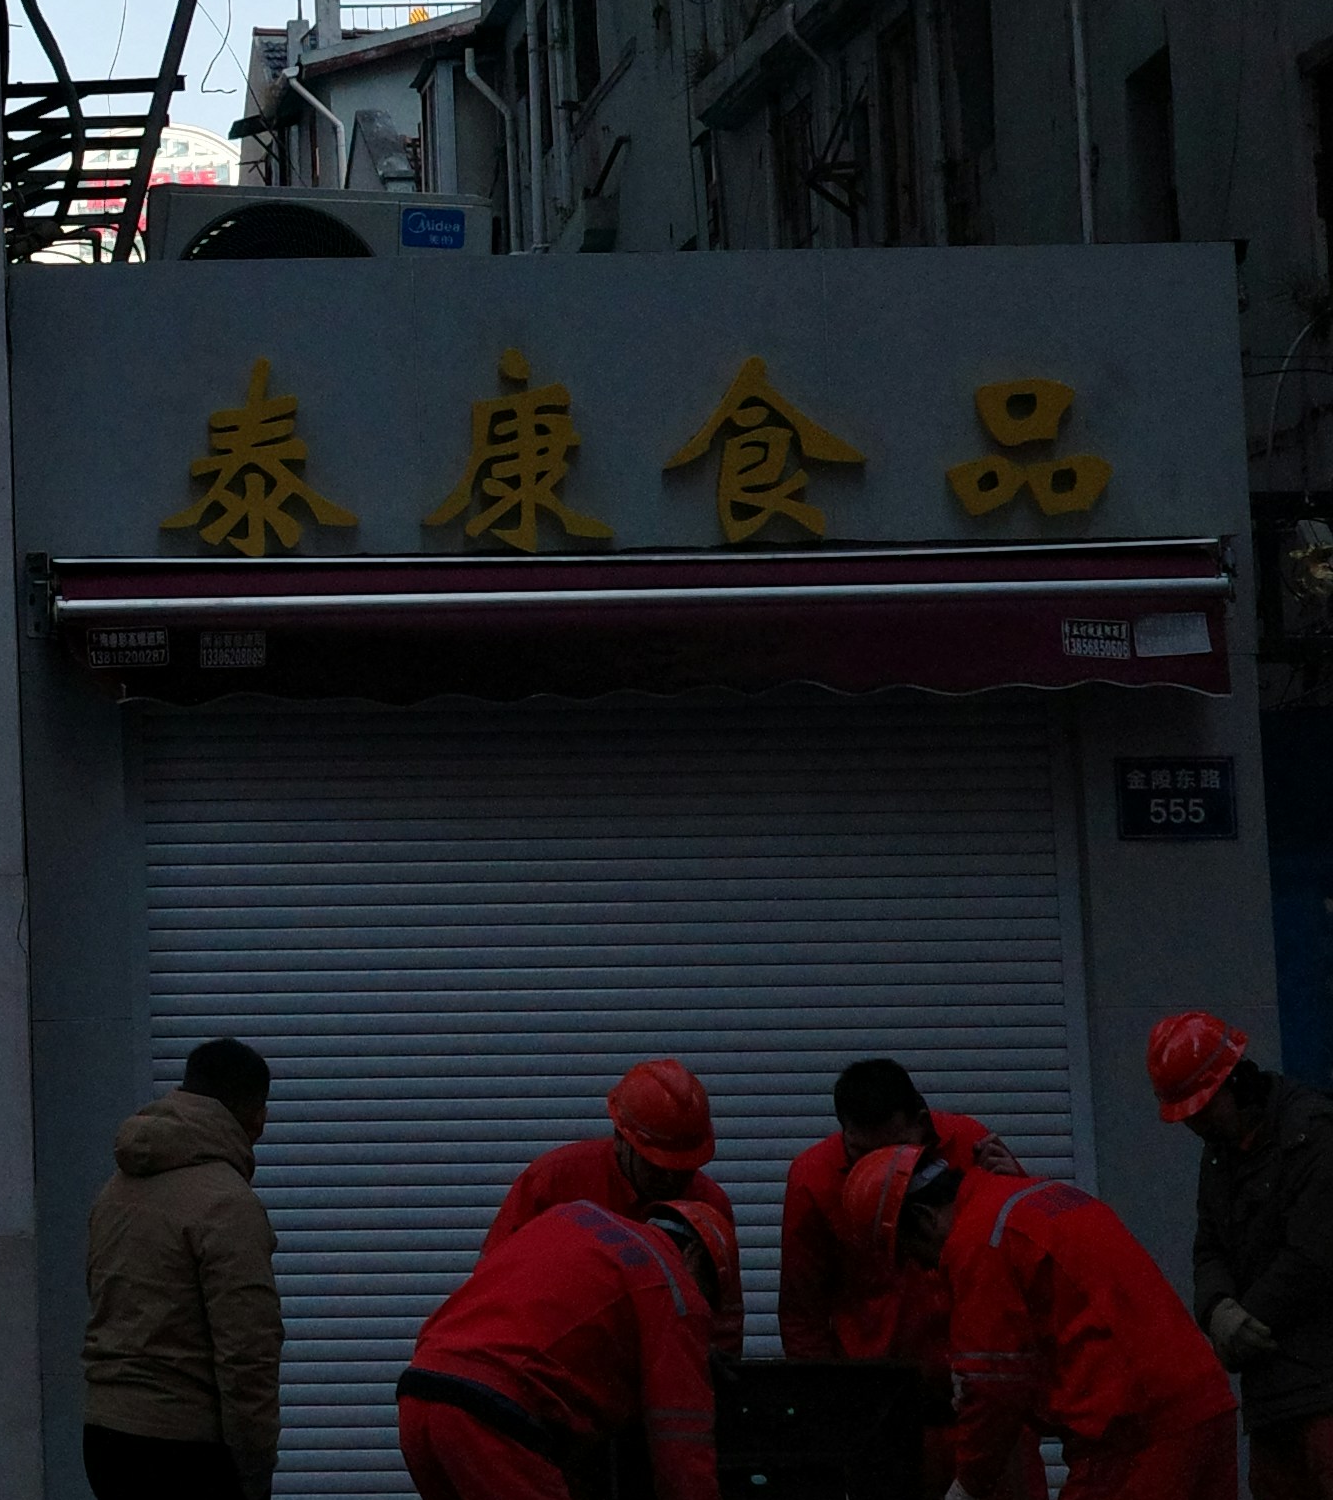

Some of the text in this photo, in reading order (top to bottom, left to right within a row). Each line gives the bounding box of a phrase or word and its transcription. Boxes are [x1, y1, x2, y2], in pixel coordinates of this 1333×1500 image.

[408, 212, 460, 233] Midea
[161, 350, 1112, 557] 泰康食品
[1126, 768, 1221, 790] 金陵东路
[1150, 798, 1205, 823] 555
